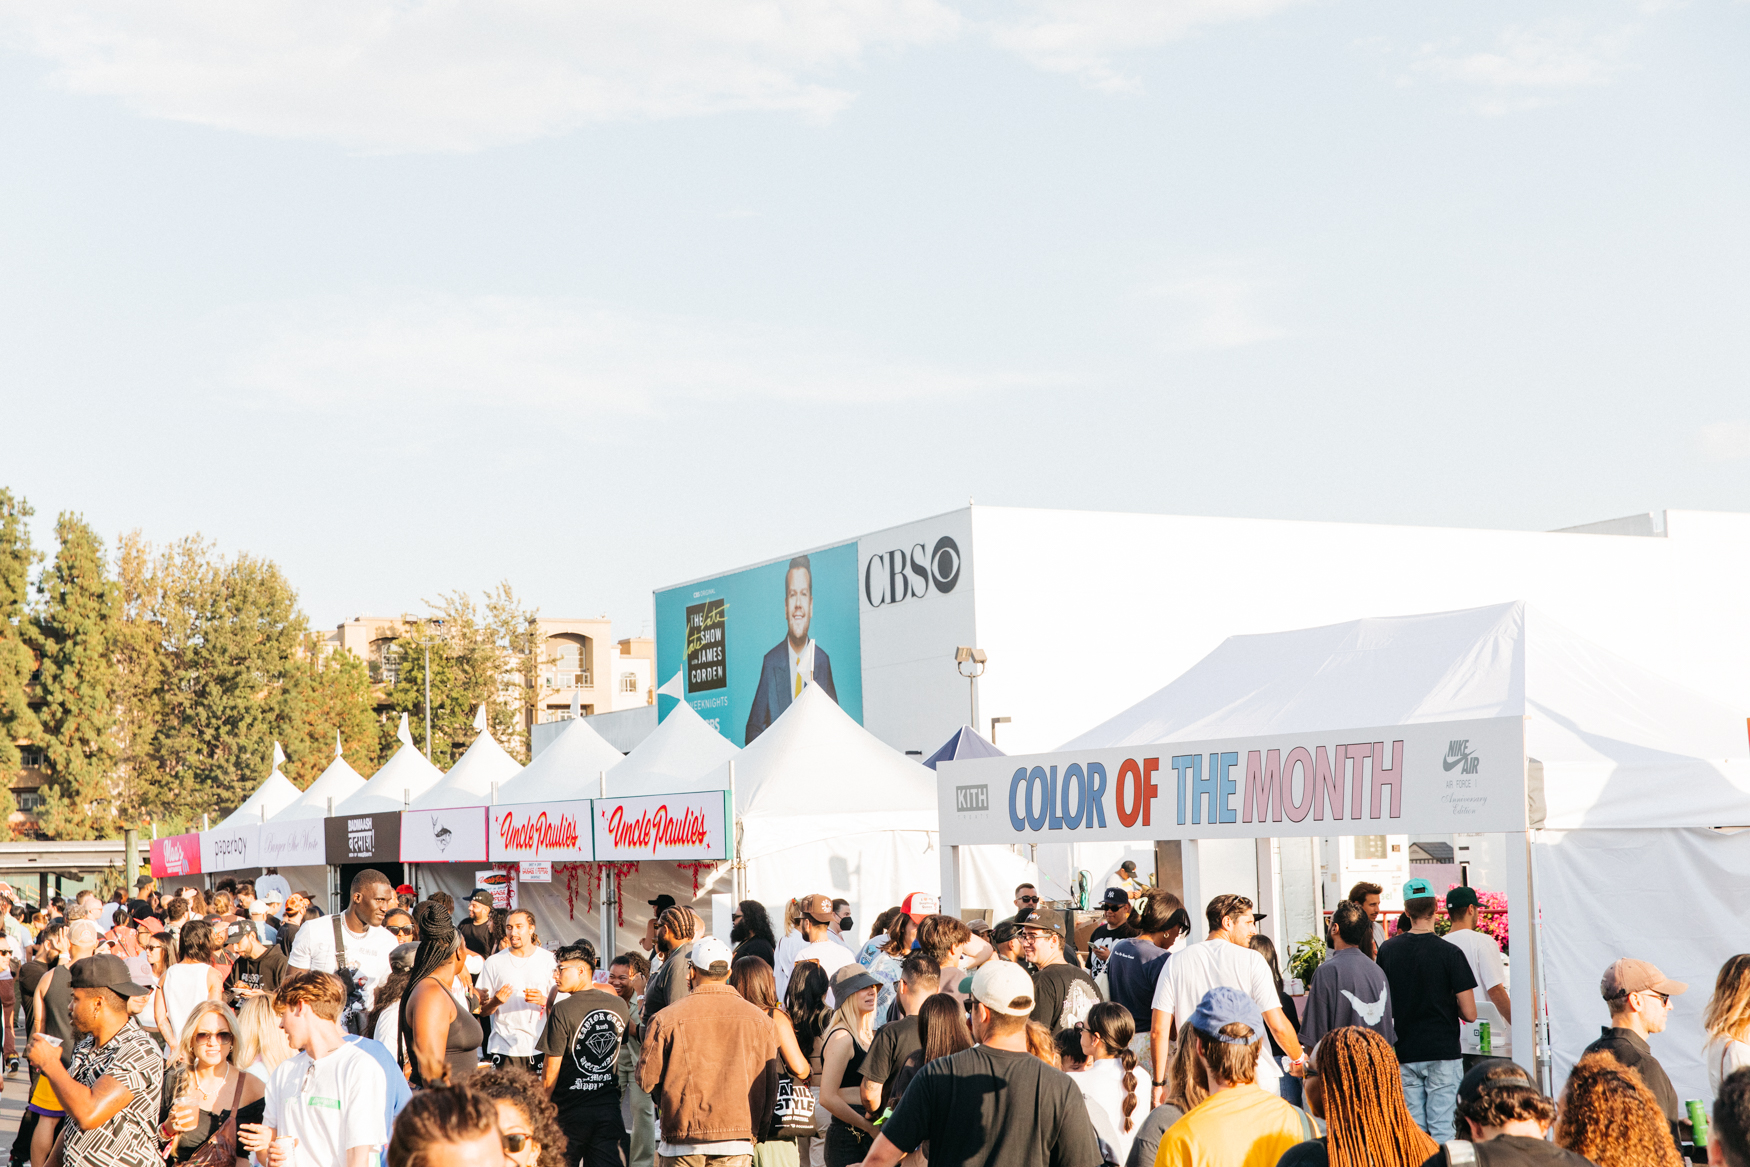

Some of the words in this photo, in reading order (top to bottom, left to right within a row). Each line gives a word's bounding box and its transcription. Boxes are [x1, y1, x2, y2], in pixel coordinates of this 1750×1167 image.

[865, 542, 929, 608] CBS
[690, 612, 703, 628] THE
[701, 628, 722, 644] SHOW
[698, 646, 722, 664] JAMES
[691, 665, 723, 683] CORDEN
[1447, 739, 1470, 757] NIKE
[1461, 756, 1480, 775] AIR
[1008, 761, 1107, 832] COLOR
[1116, 757, 1159, 828] OF
[1172, 751, 1239, 826] THE
[1242, 739, 1404, 824] MONTH
[1445, 780, 1454, 789] AIR
[1456, 779, 1471, 789] FORCE
[958, 787, 987, 808] KITH
[1441, 792, 1488, 807] Anniversary
[1452, 803, 1476, 815] Edition
[348, 817, 372, 831] BADMAASH
[608, 805, 651, 850] Uncle
[652, 804, 707, 857] Paulie's
[500, 811, 534, 851] Uncle
[535, 810, 579, 857] Paulie's
[215, 831, 248, 869] paperboy
[577, 1012, 606, 1040] TAYLOR
[775, 1097, 814, 1112] STYLE
